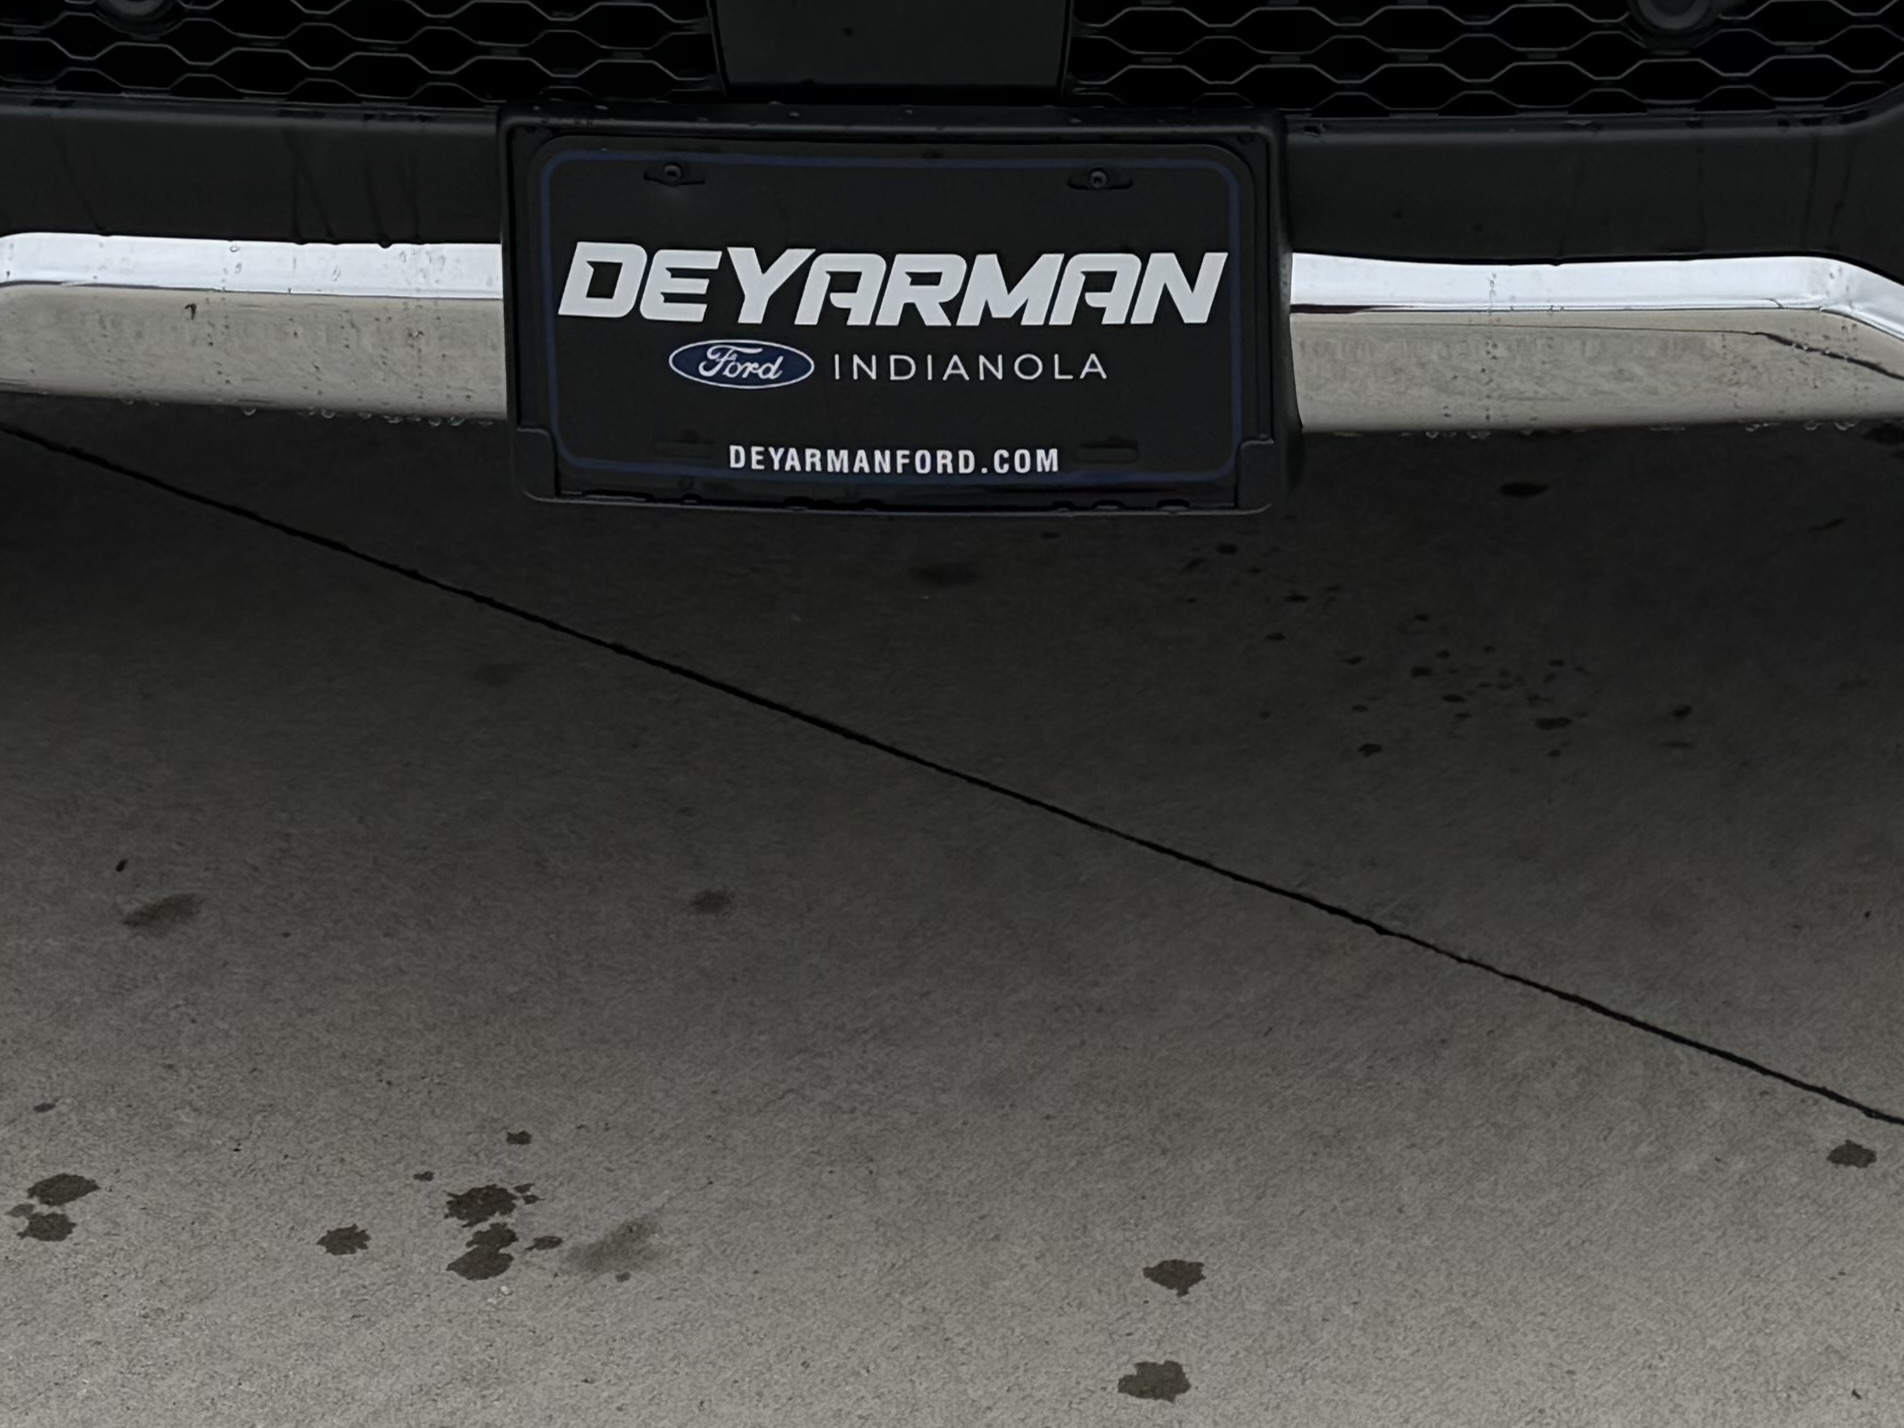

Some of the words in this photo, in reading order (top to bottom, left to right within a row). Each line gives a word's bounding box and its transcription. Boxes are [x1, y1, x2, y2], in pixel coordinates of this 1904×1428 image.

[557, 241, 1228, 327] DEYARMAN
[698, 344, 784, 381] Ford
[833, 352, 1108, 382] INDIANOLA
[728, 444, 1060, 475] DEYARMANFORD.COM
